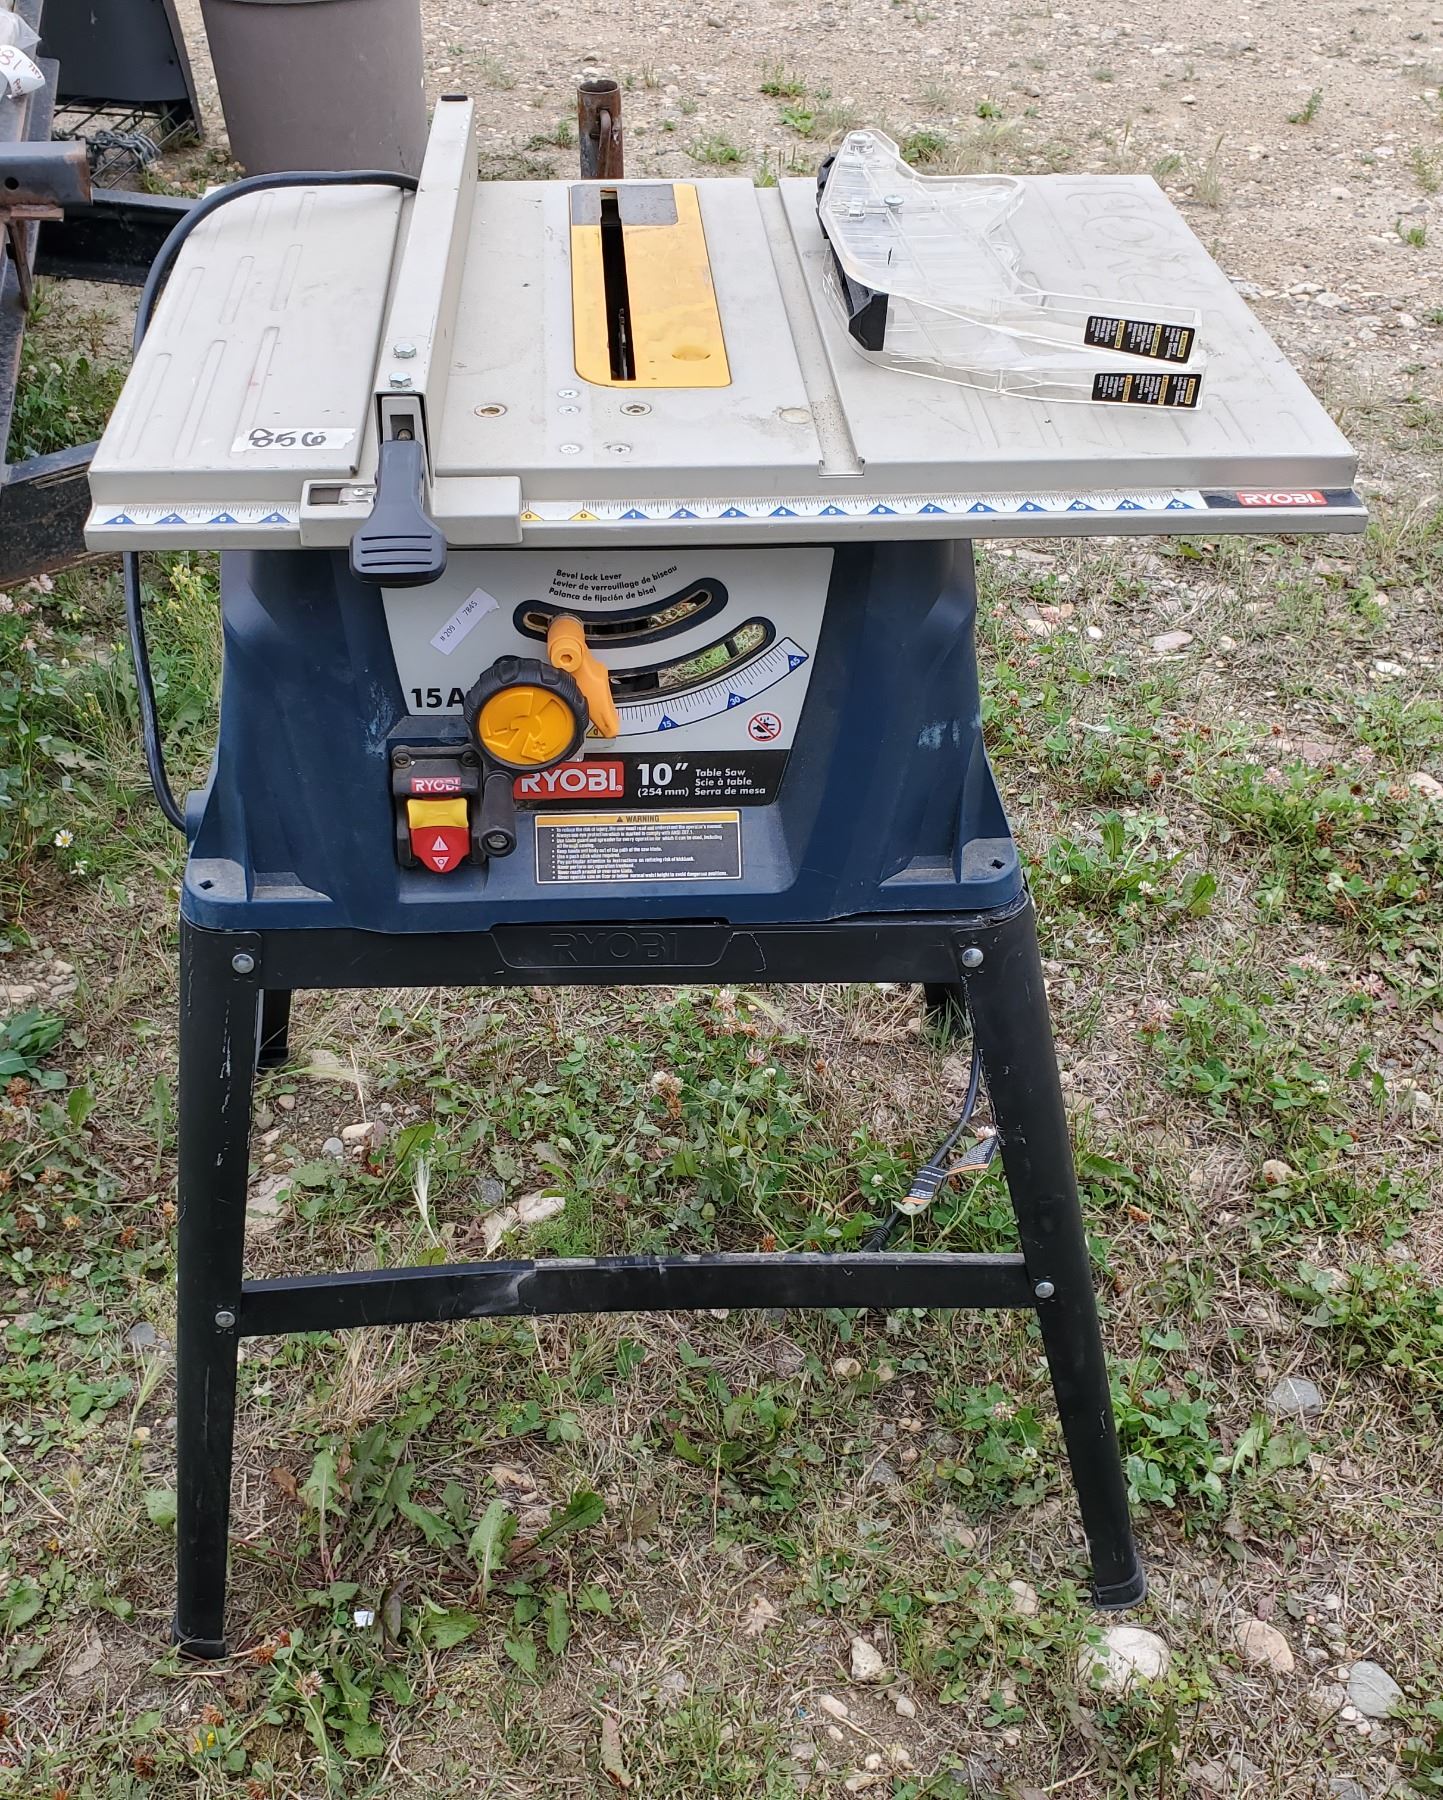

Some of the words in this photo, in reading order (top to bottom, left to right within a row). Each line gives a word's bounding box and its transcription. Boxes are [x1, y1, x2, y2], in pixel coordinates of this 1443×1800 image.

[248, 428, 327, 448] 856
[1241, 493, 1317, 504] RYOBI
[553, 578, 577, 590] Levier
[591, 580, 639, 591] verrouillage
[641, 576, 650, 584] de
[652, 565, 678, 580] biseau
[556, 569, 578, 580] Bevel
[580, 573, 598, 581] Lock
[549, 587, 580, 600] Palanca
[637, 585, 657, 597] bisel
[790, 657, 800, 667] 45
[730, 696, 741, 705] 30
[696, 768, 722, 777] Table
[725, 768, 745, 777] Saw
[522, 769, 616, 792] RYOBI
[695, 778, 714, 787] Scie
[717, 777, 724, 787] à
[727, 777, 752, 786] table
[638, 788, 662, 796] (254
[664, 788, 689, 796] mm)
[695, 788, 721, 796] Serra
[725, 787, 739, 796] de
[743, 787, 766, 795] mesa
